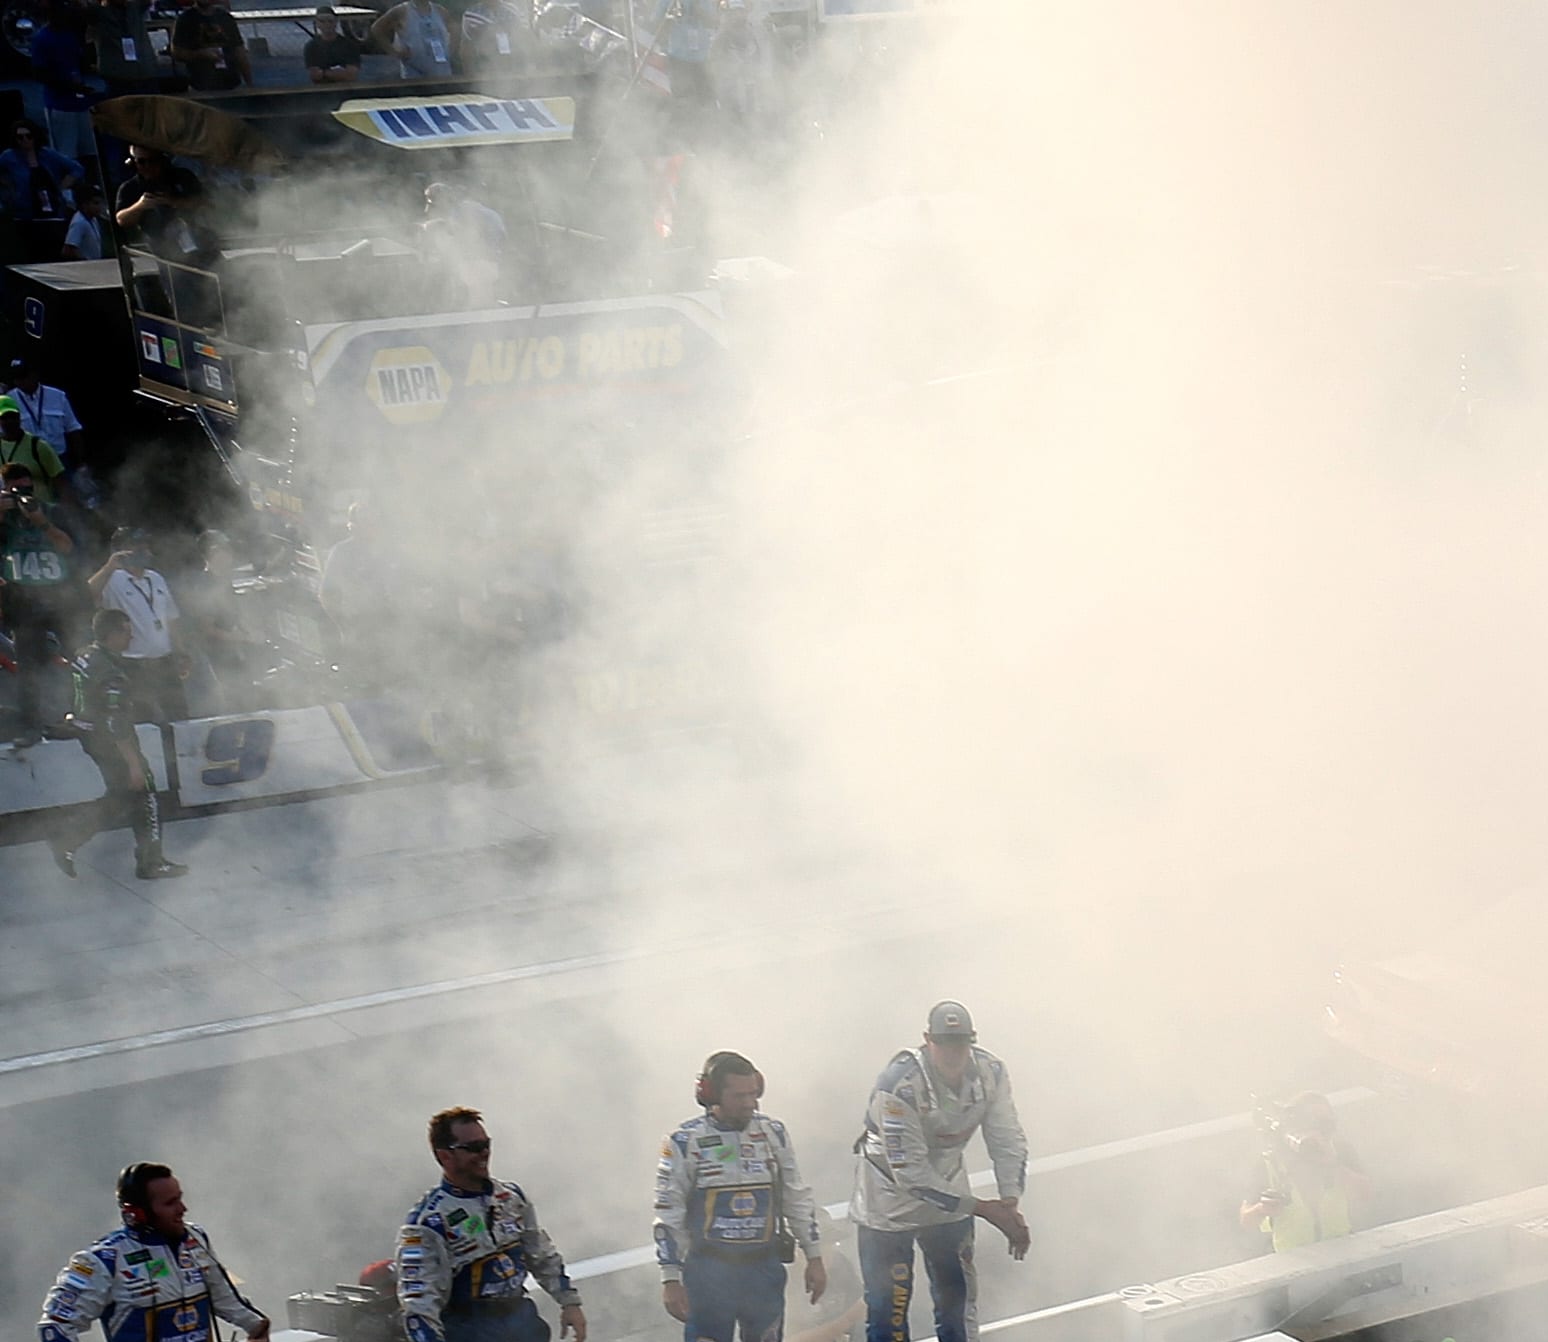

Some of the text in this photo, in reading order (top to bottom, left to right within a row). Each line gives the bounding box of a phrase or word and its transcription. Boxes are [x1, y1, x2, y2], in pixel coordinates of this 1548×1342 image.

[377, 98, 557, 138] NAPA
[25, 297, 44, 339] 9
[466, 325, 685, 386] AUTO PARTS
[378, 364, 442, 406] NAPA
[6, 551, 62, 581] 143
[201, 718, 276, 787] 9
